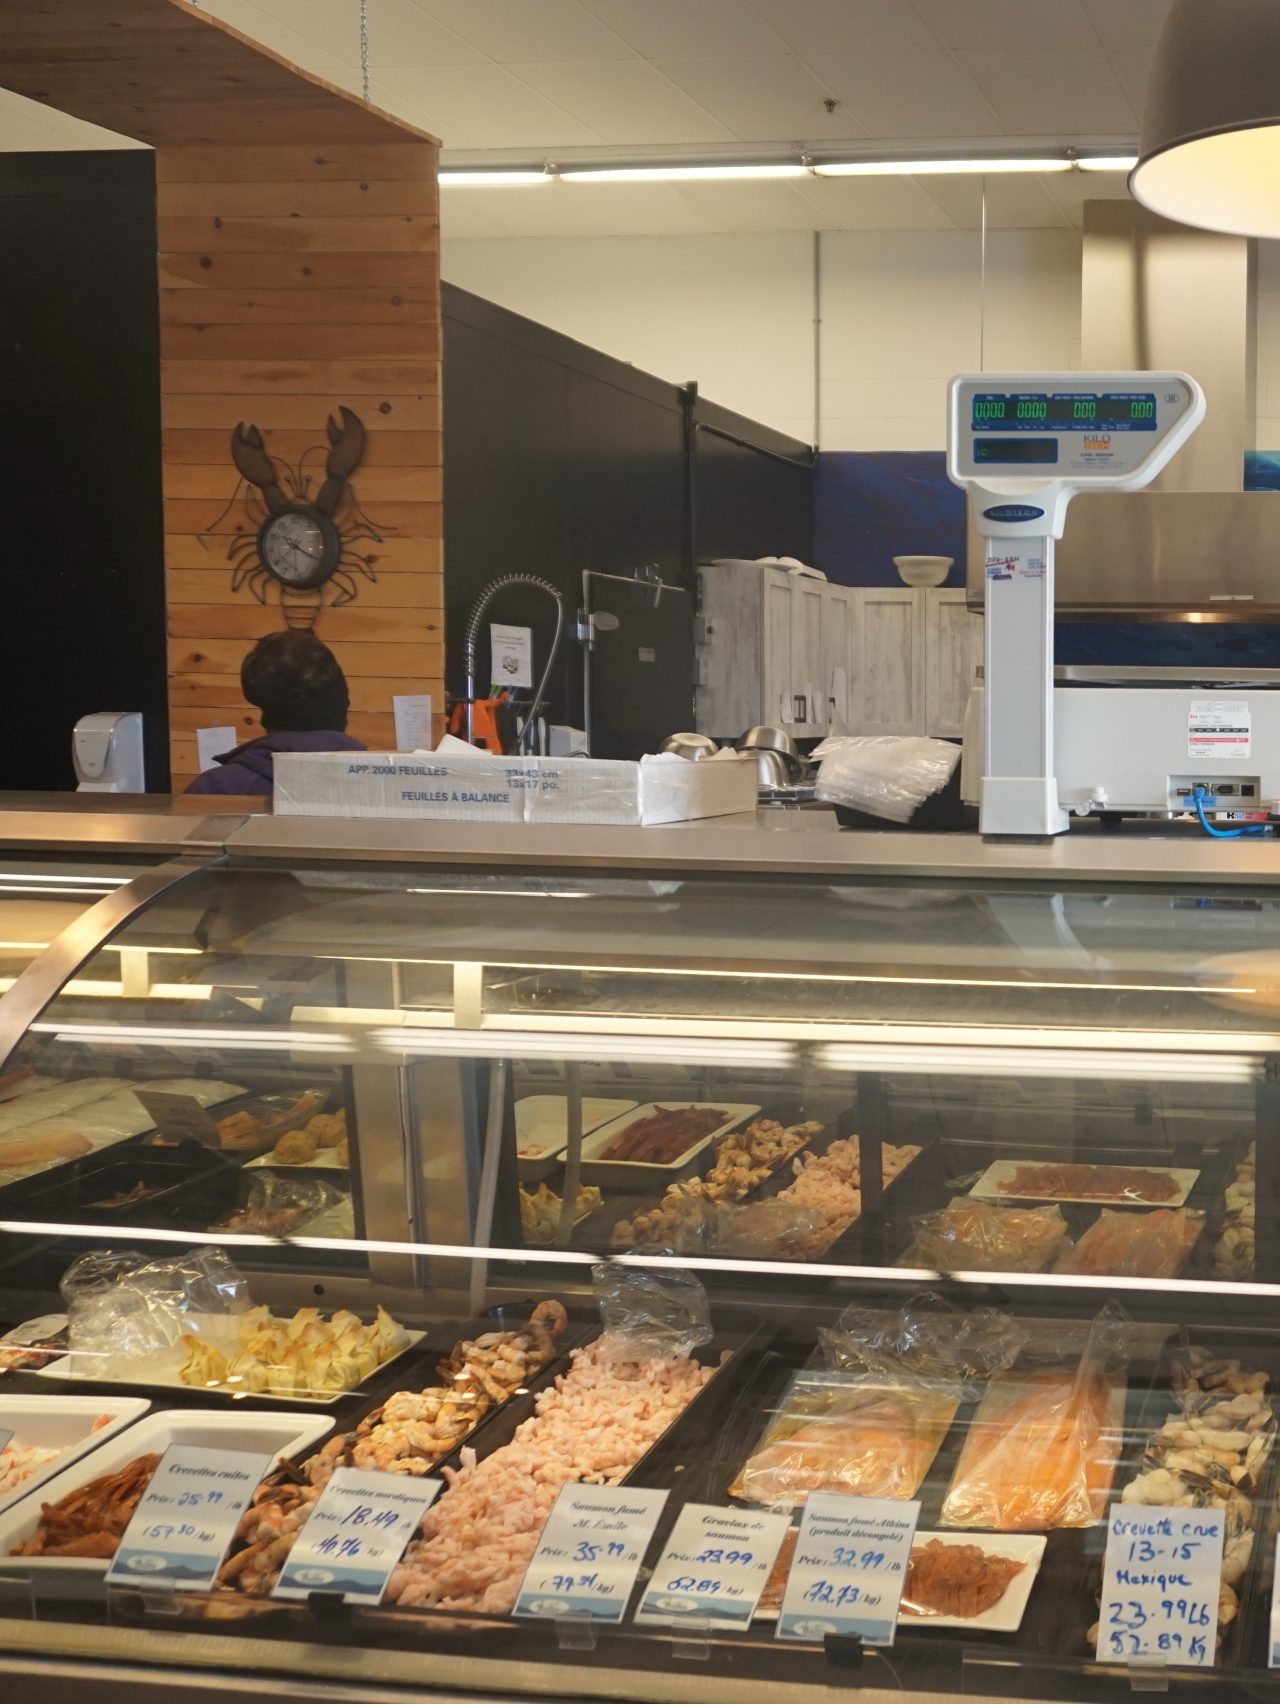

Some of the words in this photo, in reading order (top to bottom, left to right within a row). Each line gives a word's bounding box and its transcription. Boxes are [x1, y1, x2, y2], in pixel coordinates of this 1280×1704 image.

[1083, 434, 1110, 442] KILO
[372, 766, 396, 775] 2000
[399, 766, 448, 777] FEUILLES
[402, 791, 449, 802] FEUILLES
[451, 789, 458, 802] À
[461, 793, 510, 803] BALANCE
[169, 1463, 218, 1478] Crevettes
[217, 1470, 251, 1482] cuites
[330, 1485, 375, 1498] Crevettes
[569, 1501, 615, 1514] Saumon
[613, 1504, 648, 1516] fumé
[702, 1515, 750, 1530] Gravlax
[750, 1522, 765, 1531] de
[808, 1512, 849, 1524] Saumon
[847, 1516, 875, 1527] fumé
[875, 1519, 910, 1530] Atkins
[704, 1531, 750, 1542] saumon
[809, 1526, 851, 1538] (produit
[851, 1529, 904, 1543] décongelé)
